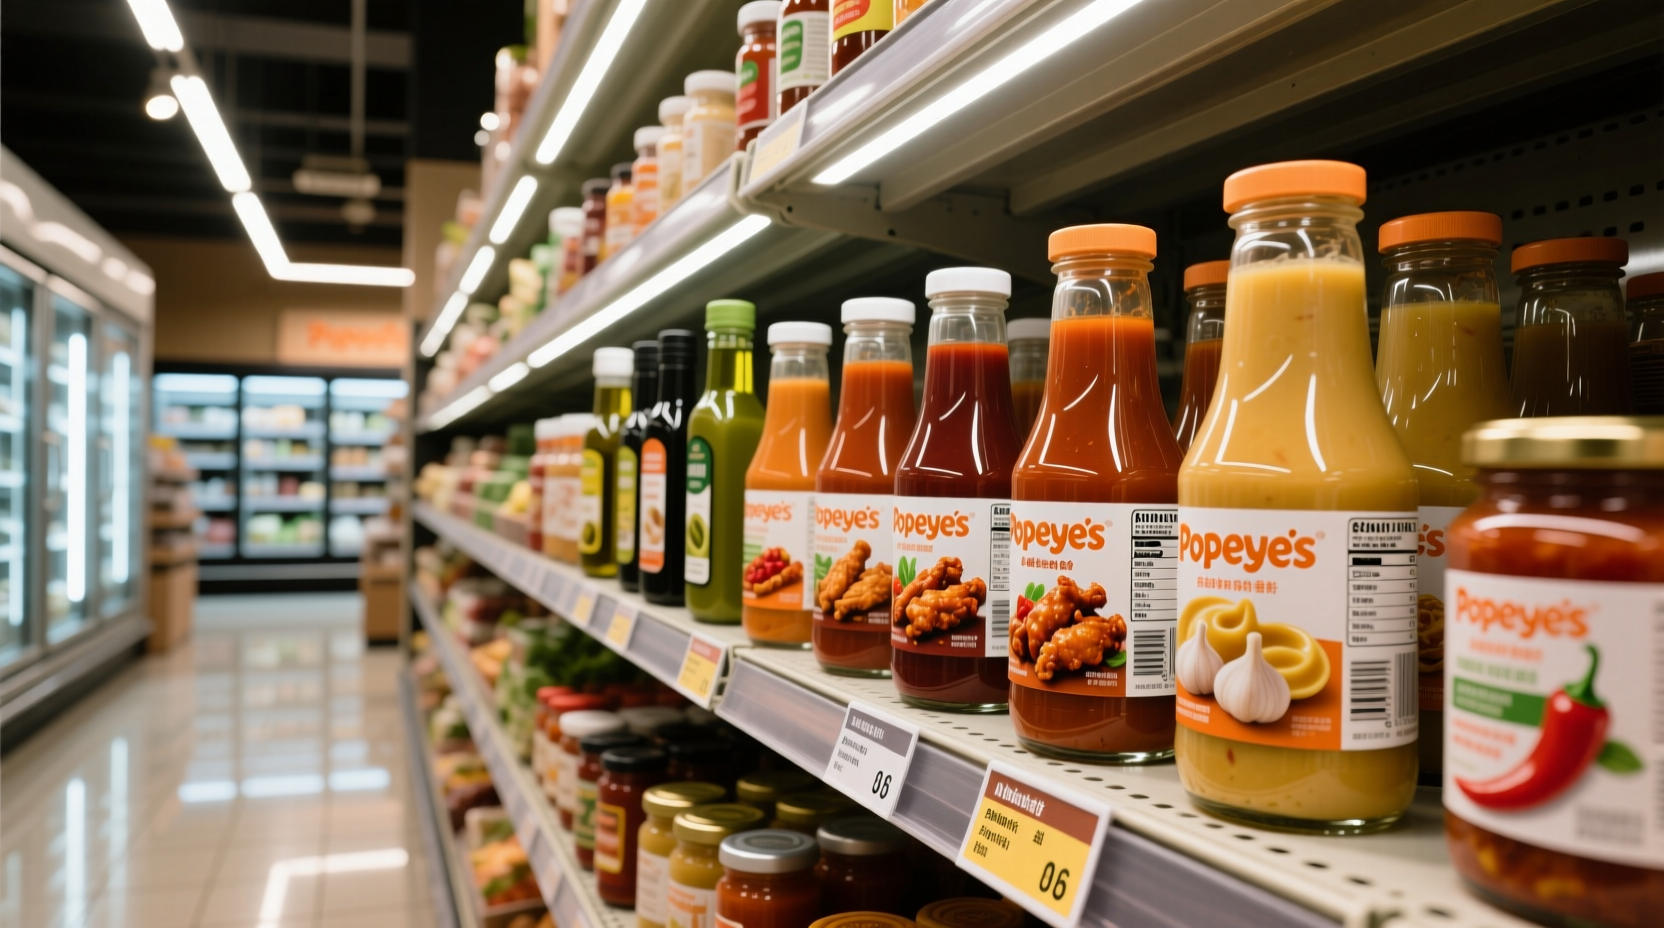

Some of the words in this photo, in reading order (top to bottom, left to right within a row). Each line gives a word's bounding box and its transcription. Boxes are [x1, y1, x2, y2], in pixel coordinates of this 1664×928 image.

[815, 503, 880, 533] opeye's
[893, 506, 969, 540] Popeye's
[1179, 522, 1316, 573] Popeye's
[1455, 587, 1591, 639] Popeye's
[872, 770, 892, 799] 06
[1039, 861, 1070, 900] 06
